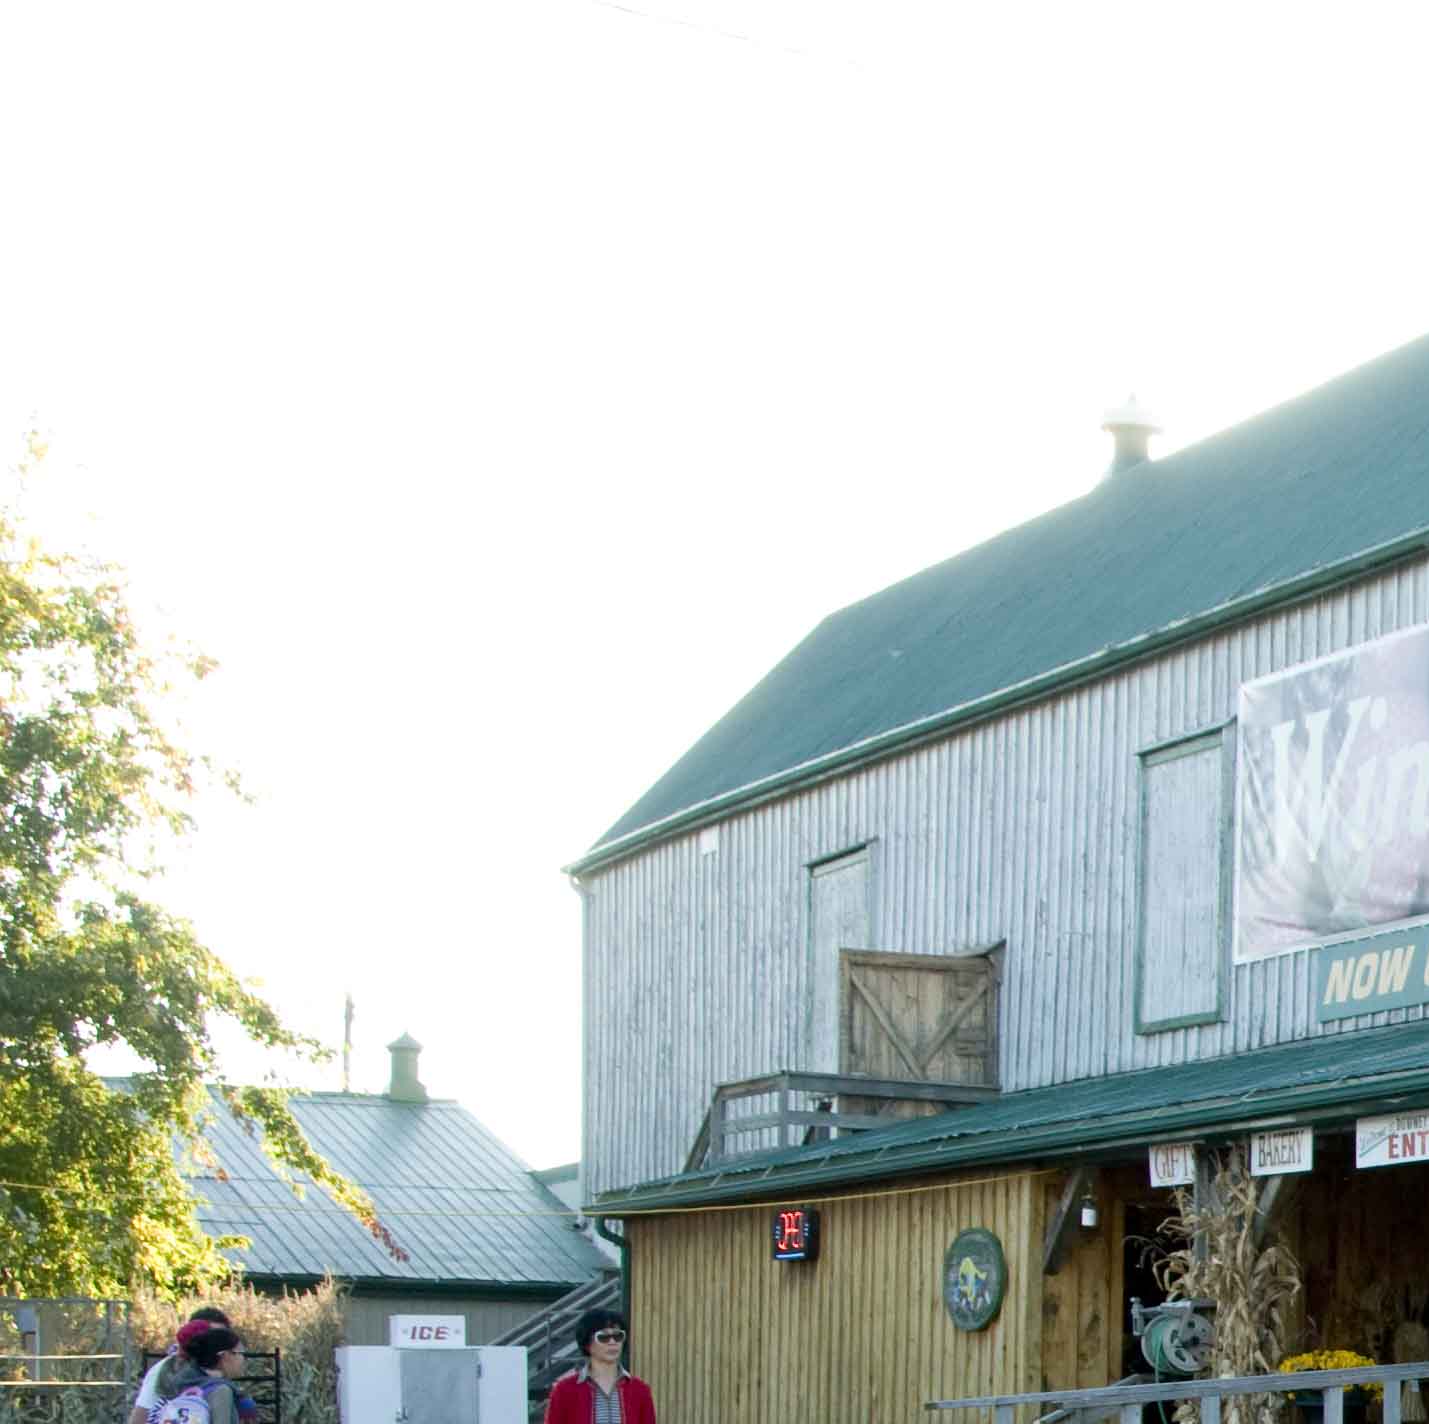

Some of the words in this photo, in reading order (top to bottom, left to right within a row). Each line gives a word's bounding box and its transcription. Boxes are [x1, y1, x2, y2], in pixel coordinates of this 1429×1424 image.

[1323, 944, 1415, 1006] NOW
[1258, 1130, 1305, 1168] BAKERY
[410, 1325, 449, 1341] ICE
